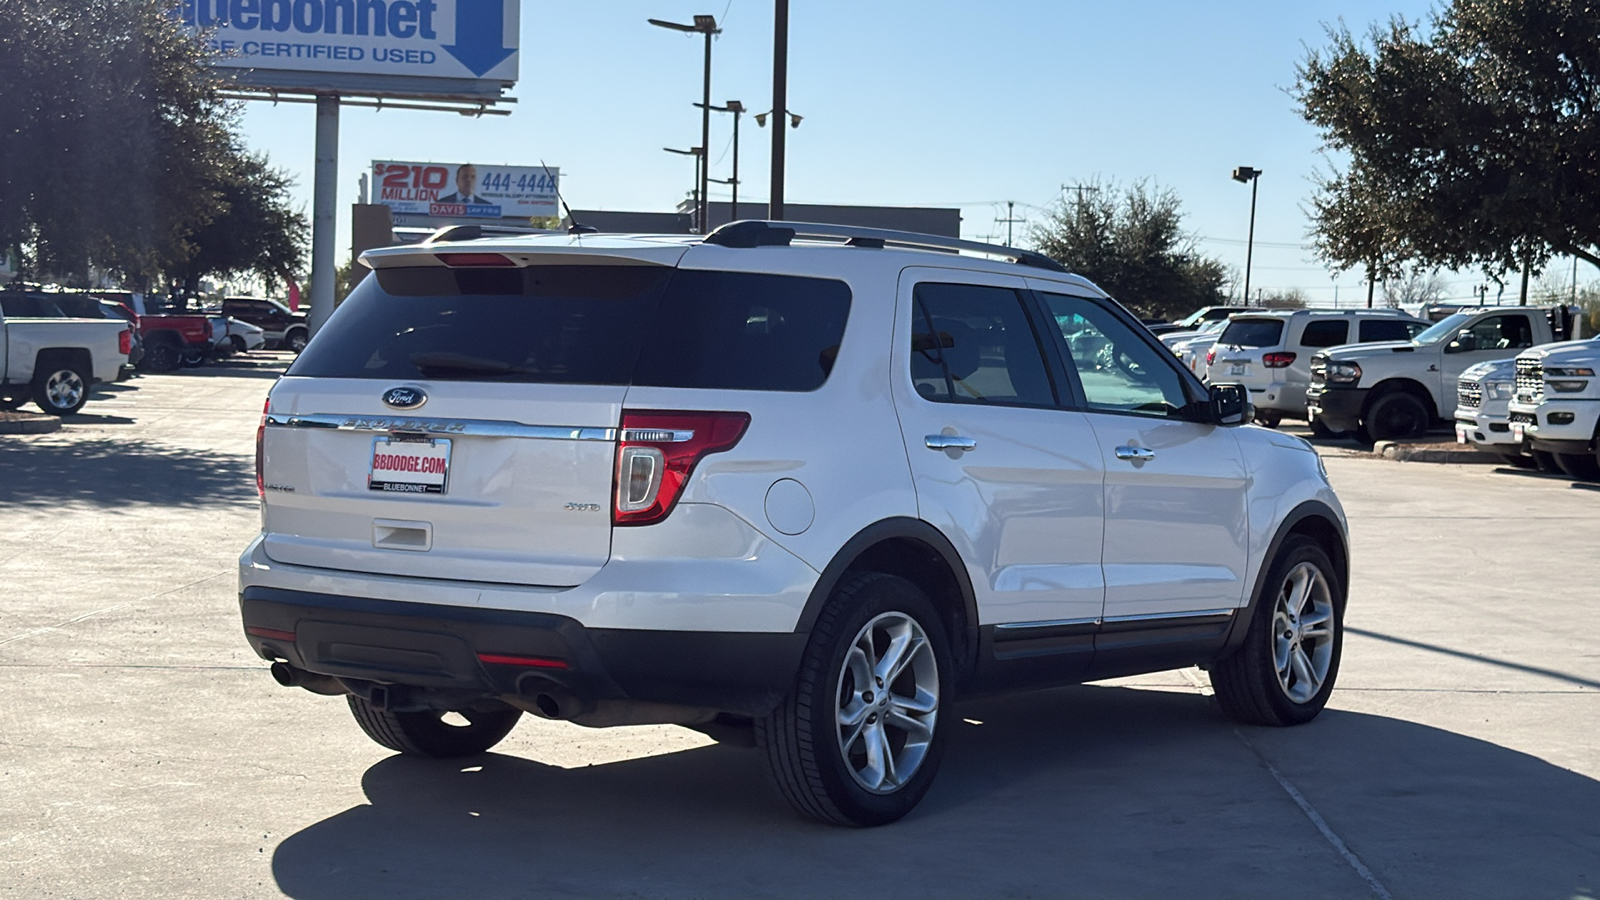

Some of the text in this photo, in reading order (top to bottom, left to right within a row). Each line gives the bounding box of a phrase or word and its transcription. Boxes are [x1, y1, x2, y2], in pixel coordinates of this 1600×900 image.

[167, 0, 437, 39] luebonnet
[243, 41, 365, 60] CERTIFIED
[373, 47, 436, 64] USED
[375, 163, 449, 189] $210
[481, 172, 555, 192] 444-4444
[381, 187, 439, 202] MILLION
[431, 204, 465, 215] DAVIS
[388, 390, 415, 403] Ford
[373, 453, 446, 475] BBDODGE.COM
[383, 482, 428, 493] BLUEBONNET
[563, 501, 601, 512] 4WD
